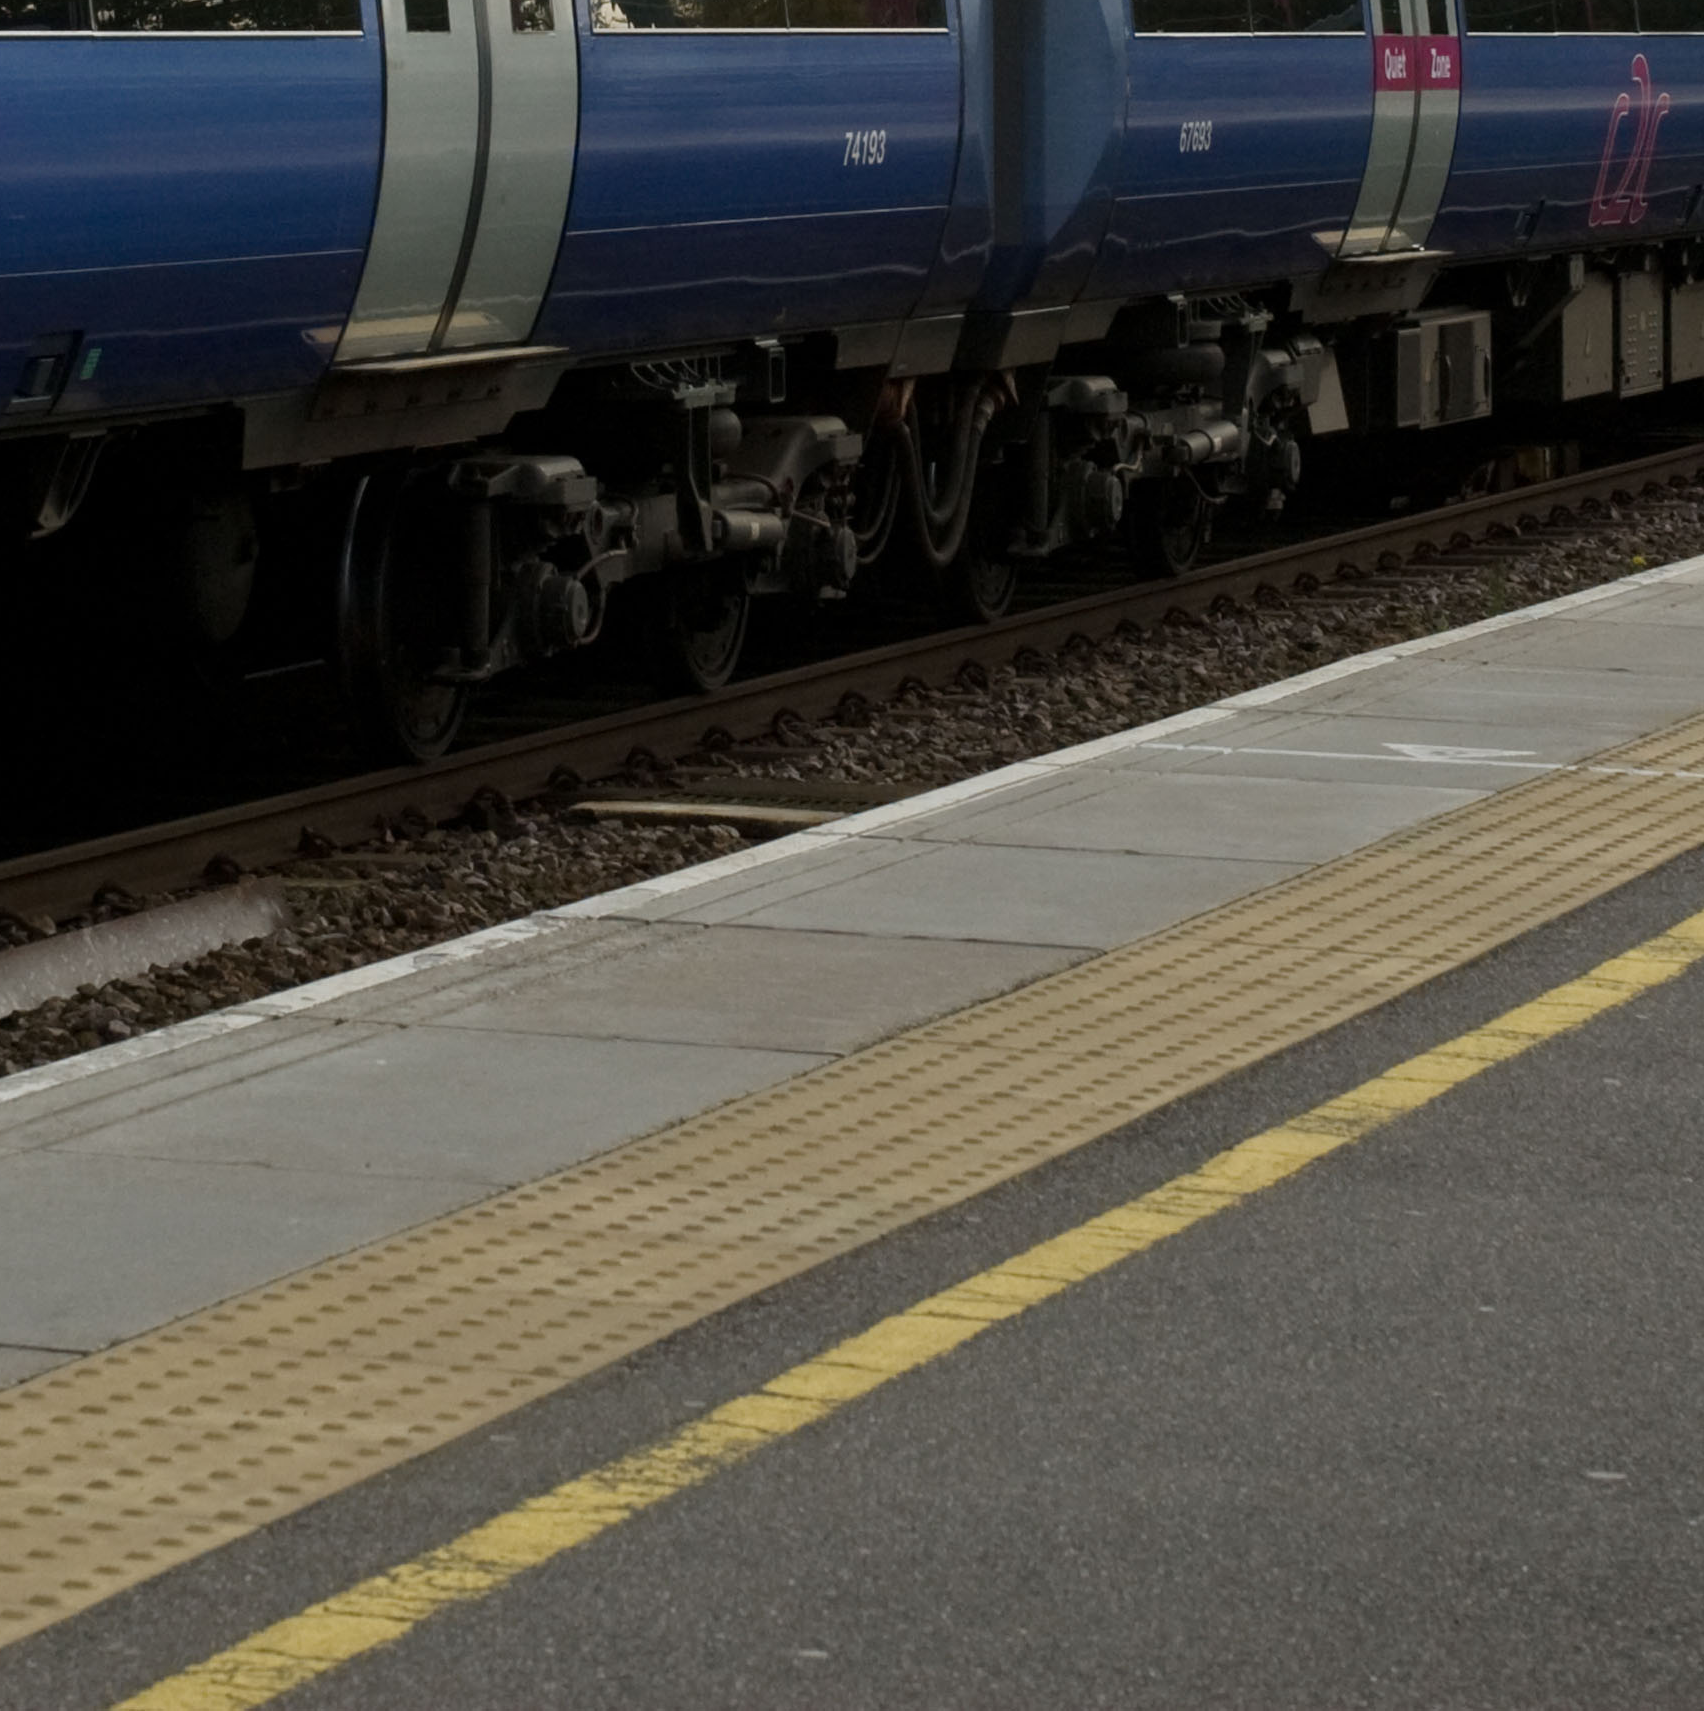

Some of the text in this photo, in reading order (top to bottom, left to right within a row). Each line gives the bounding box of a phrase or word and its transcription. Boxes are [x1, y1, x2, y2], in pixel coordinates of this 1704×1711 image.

[1384, 47, 1451, 80] Quiet Zone
[843, 129, 887, 167] 74193
[1179, 120, 1213, 154] 67693
[1588, 53, 1671, 226] c2c
